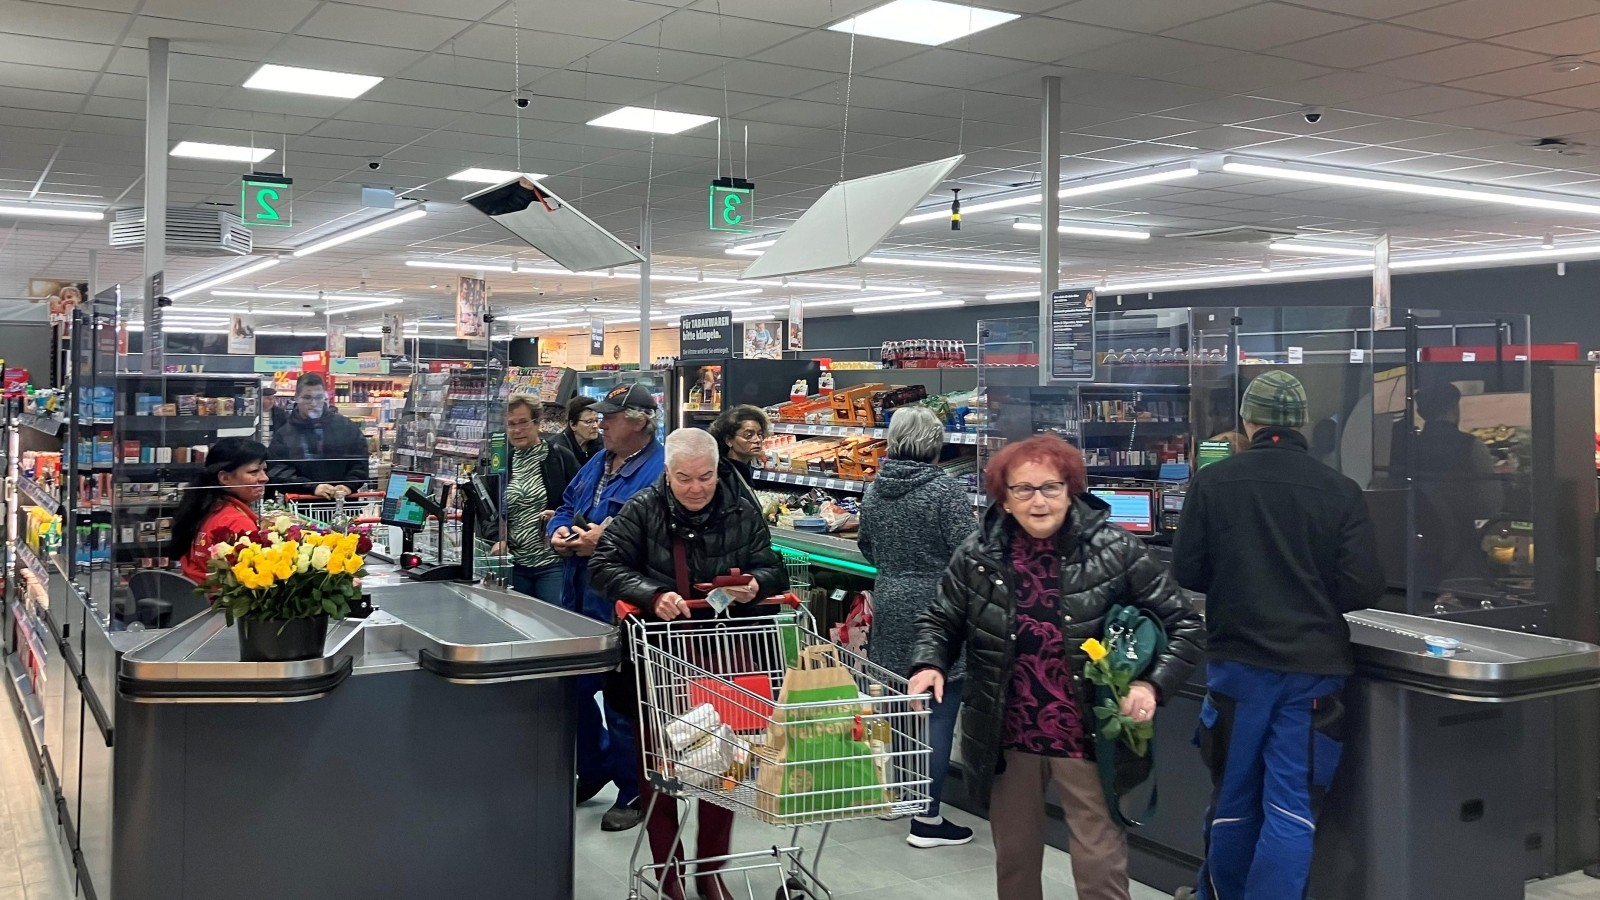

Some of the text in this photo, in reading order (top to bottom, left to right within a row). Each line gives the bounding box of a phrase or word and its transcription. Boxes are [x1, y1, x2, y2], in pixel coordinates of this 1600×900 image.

[683, 317, 729, 329] Für TABAKWAREN
[683, 329, 721, 341] bitte klingeln.
